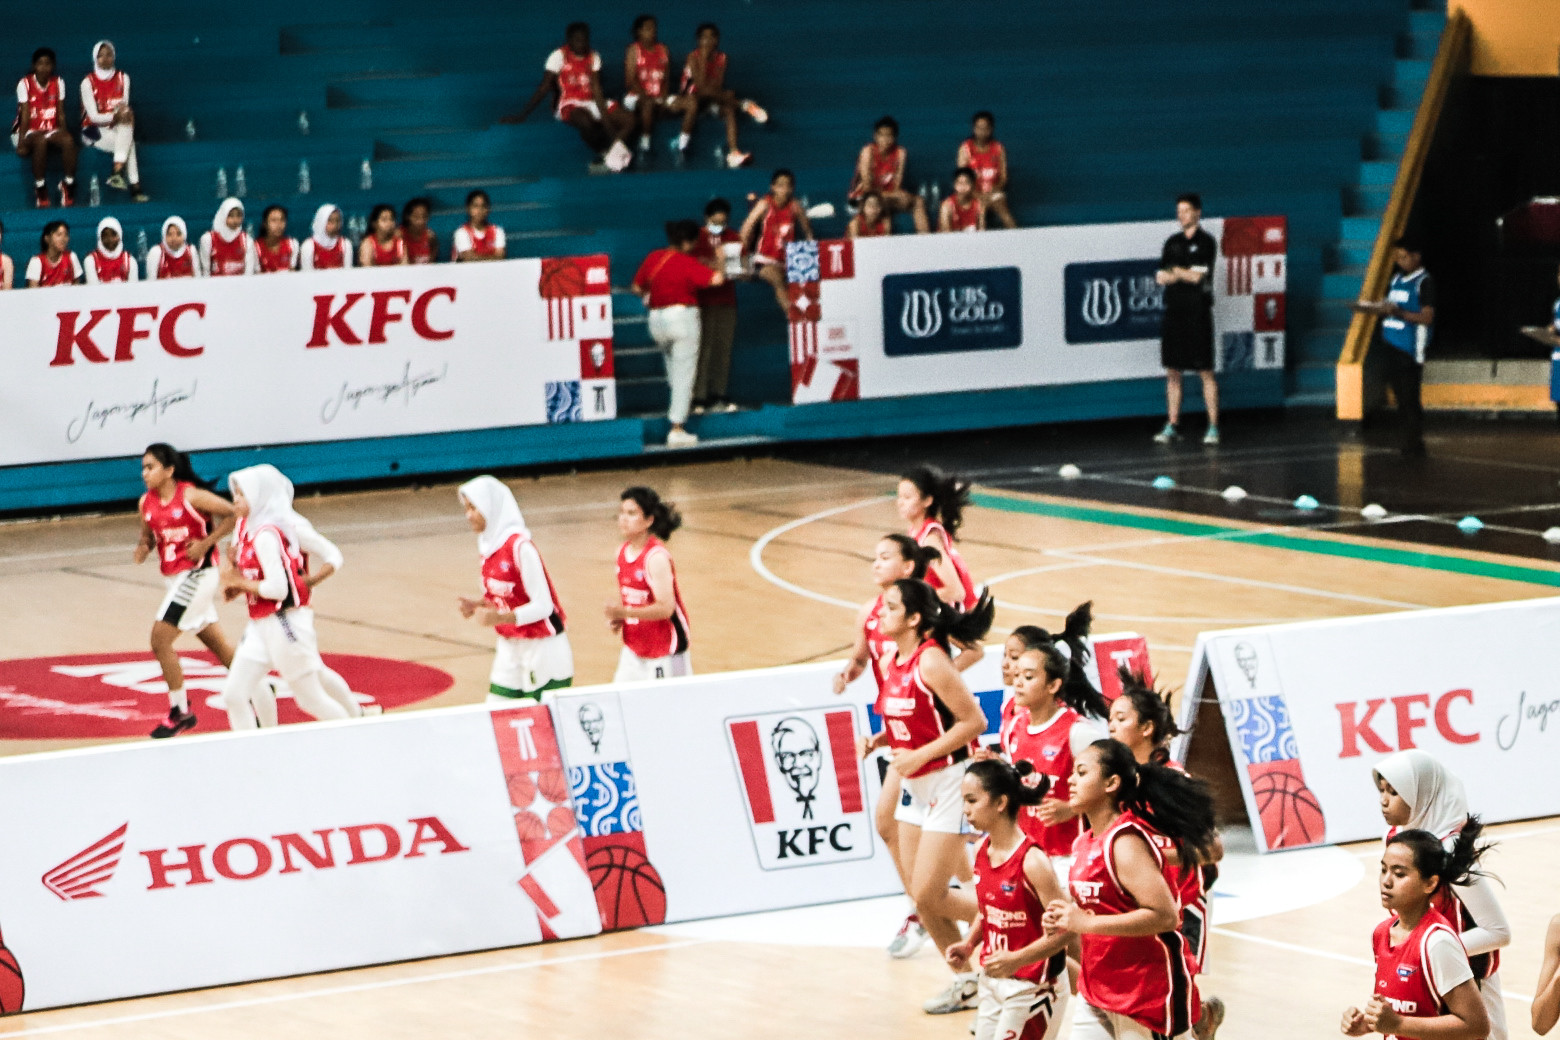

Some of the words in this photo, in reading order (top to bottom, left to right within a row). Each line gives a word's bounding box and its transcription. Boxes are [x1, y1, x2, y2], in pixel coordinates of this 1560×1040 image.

[49, 302, 206, 367] KFC
[307, 286, 457, 348] KFC
[950, 302, 1004, 322] GOLD
[1335, 687, 1480, 758] KFC
[140, 815, 469, 891] HONDA
[776, 823, 852, 860] KFC
